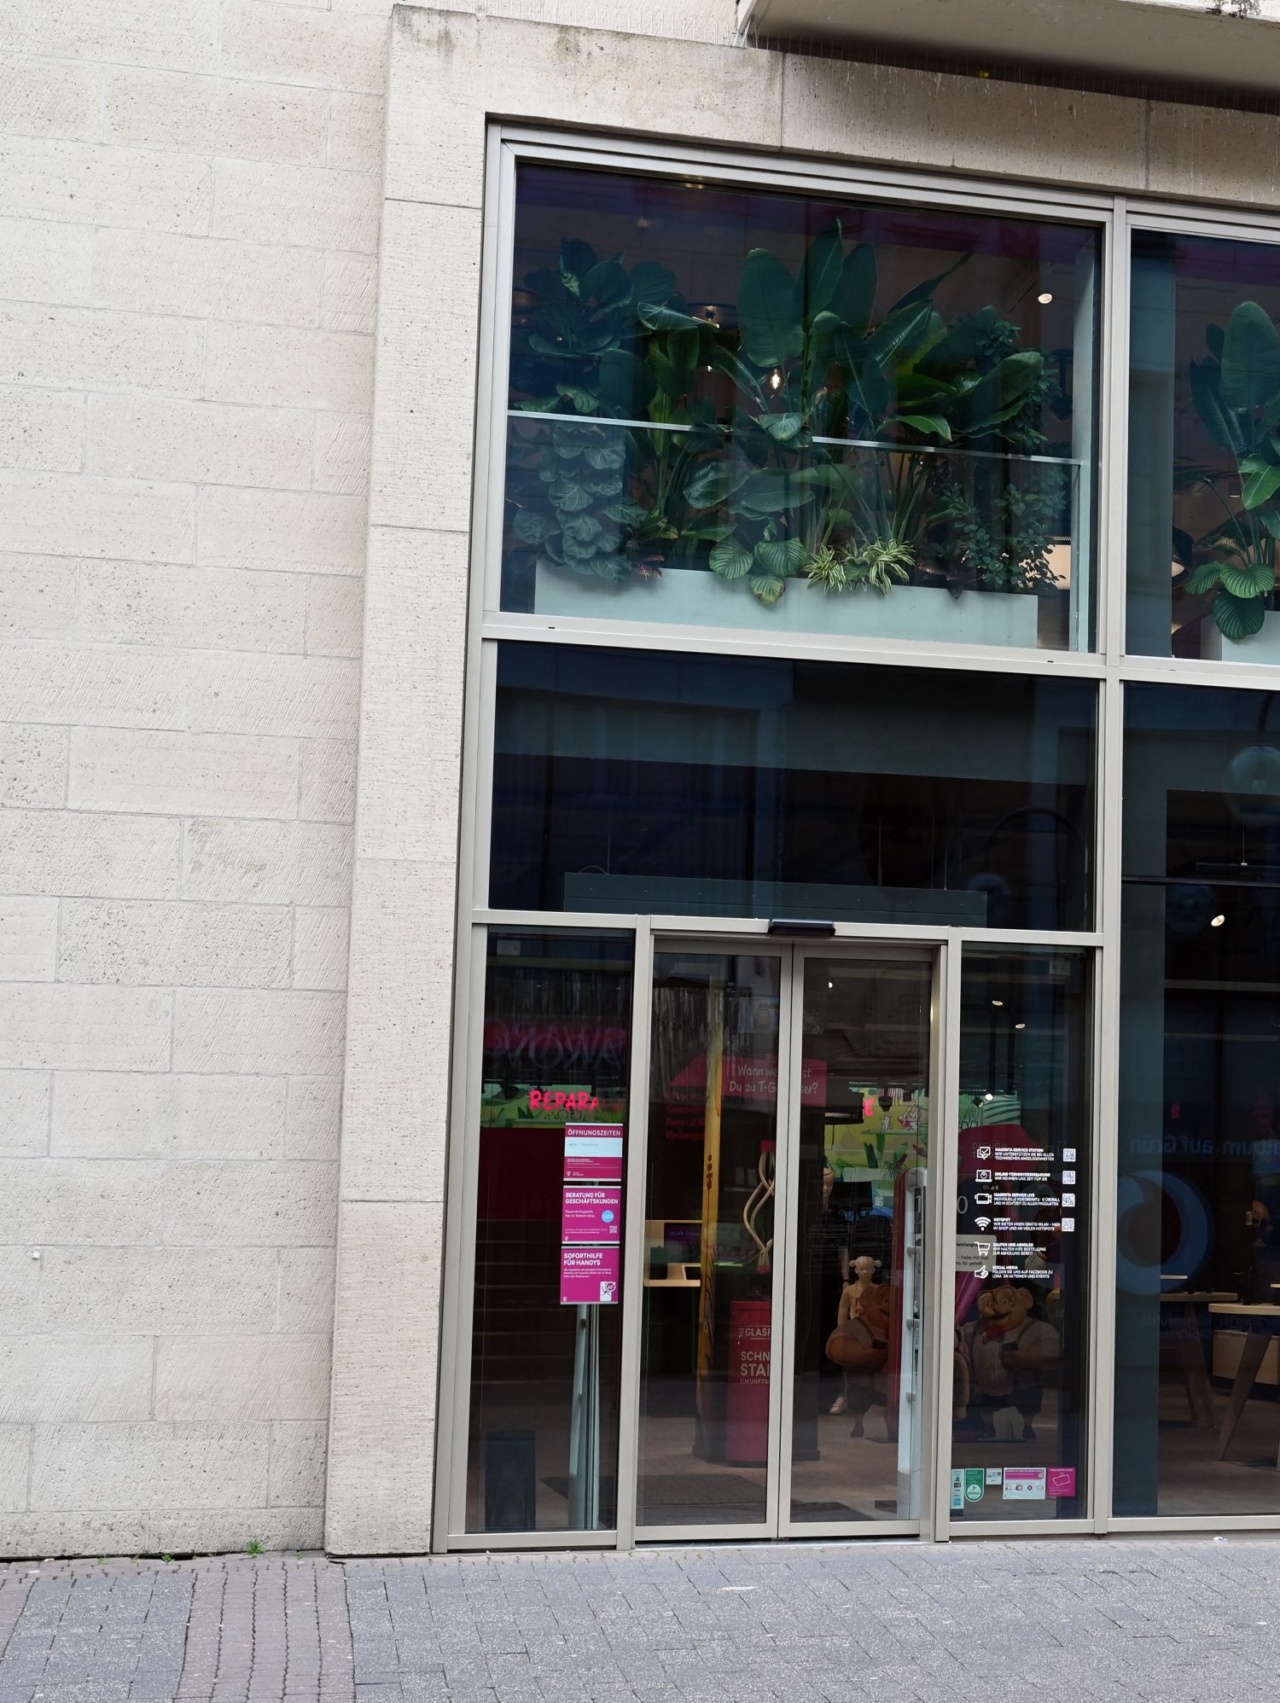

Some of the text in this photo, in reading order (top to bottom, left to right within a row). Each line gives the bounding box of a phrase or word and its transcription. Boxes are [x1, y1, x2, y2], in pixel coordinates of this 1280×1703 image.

[738, 1065, 764, 1077] Wann
[729, 1080, 743, 1092] Du
[744, 1084, 756, 1092] zu
[567, 1128, 621, 1136] ÖFFNUNGSZEITEN
[563, 1258, 576, 1266] FÜR
